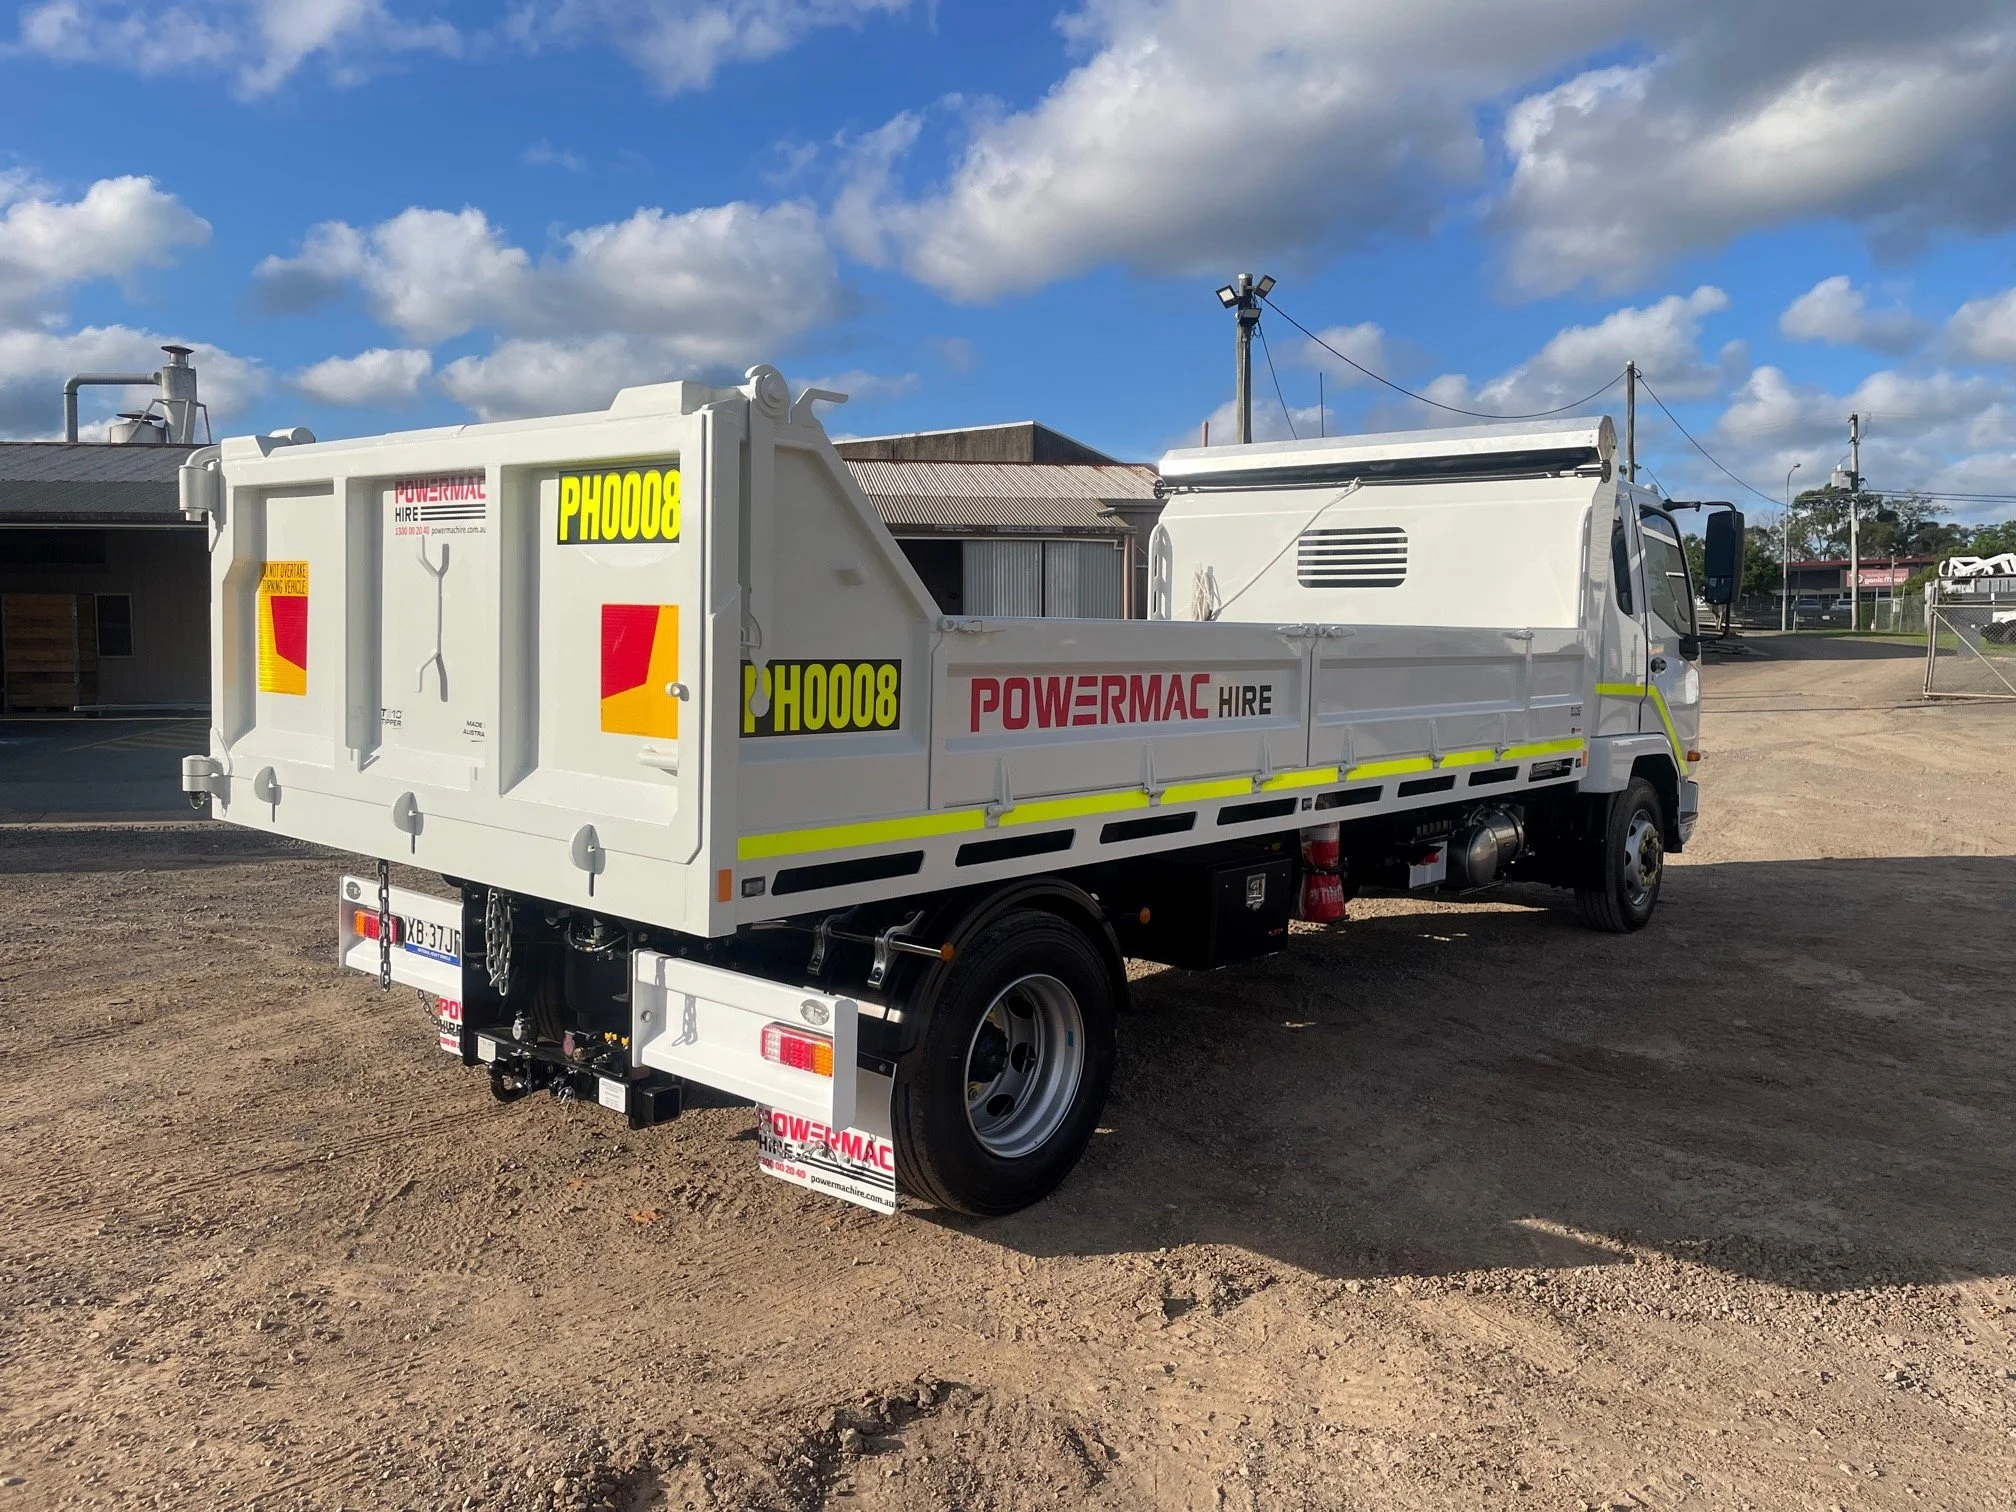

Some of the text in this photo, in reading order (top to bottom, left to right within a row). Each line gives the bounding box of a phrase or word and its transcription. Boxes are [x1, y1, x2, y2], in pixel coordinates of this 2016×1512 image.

[395, 476, 486, 504] POWERMAC
[395, 507, 418, 522] HIRE
[560, 469, 680, 541] PH0008
[395, 526, 408, 536] 1300
[744, 663, 898, 733] PH0008
[970, 674, 1272, 732] POWERMAC HIRE
[758, 1107, 895, 1172] POWERMAC
[775, 1161, 785, 1172] 00
[785, 1165, 796, 1176] 20
[795, 1169, 807, 1179] 40
[810, 1175, 895, 1208] powermachire.com.au
